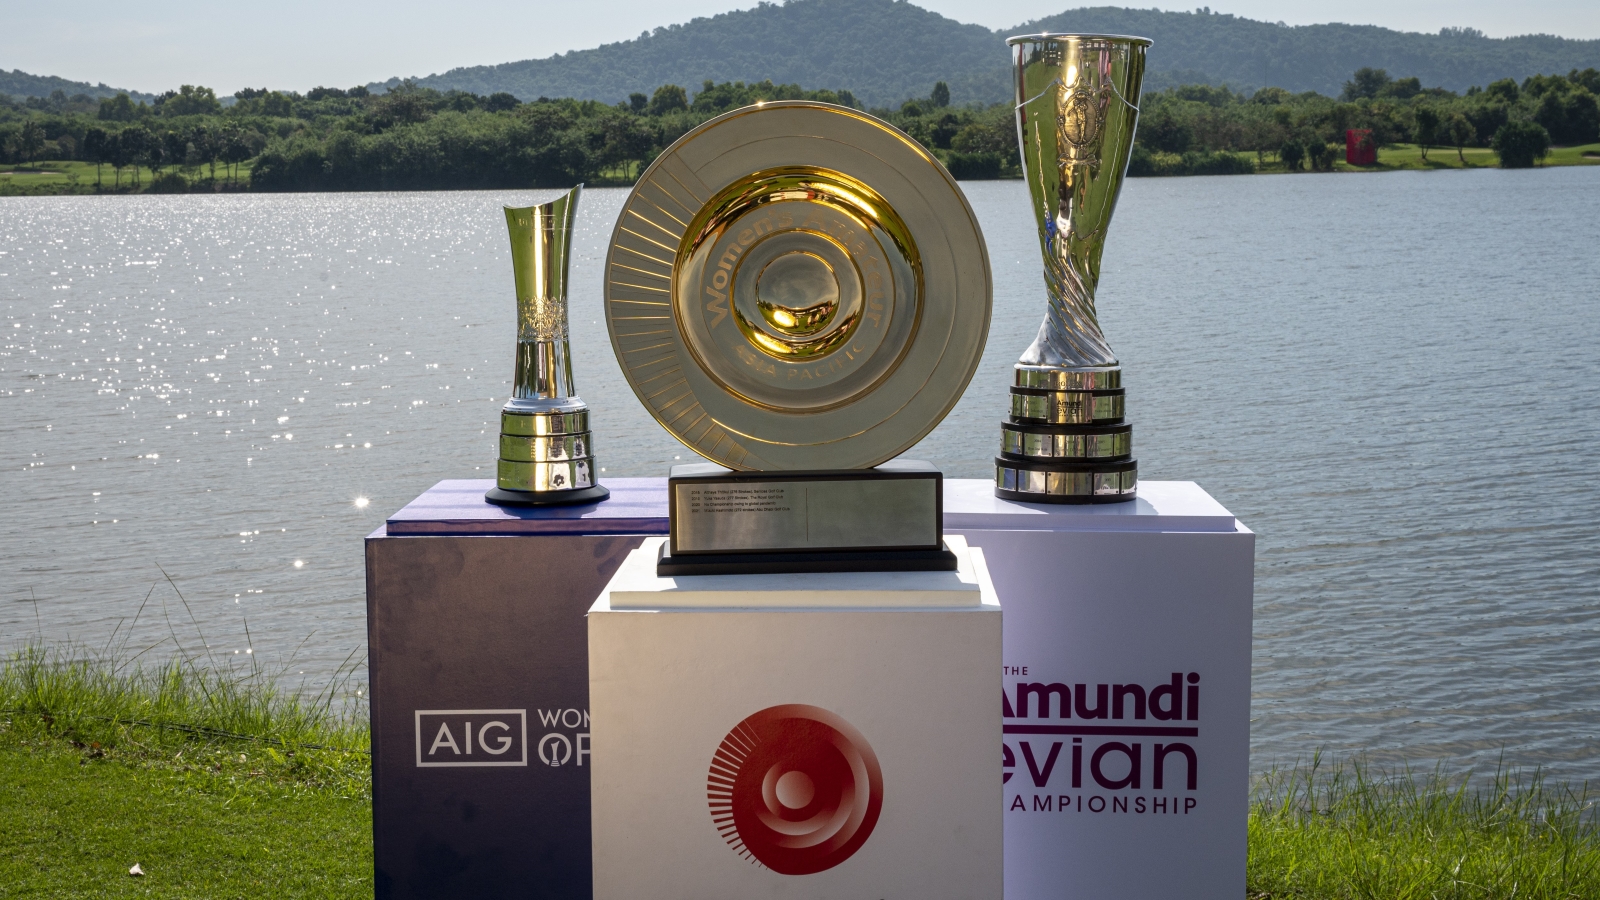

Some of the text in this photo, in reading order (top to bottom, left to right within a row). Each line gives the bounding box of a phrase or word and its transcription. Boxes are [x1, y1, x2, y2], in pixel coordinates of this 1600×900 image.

[706, 207, 885, 329] Women's Amateur
[787, 340, 866, 381] PACIFIC
[1003, 666, 1029, 676] THE
[428, 720, 513, 755] AIG
[1010, 794, 1197, 815] AMPIONSHIP
